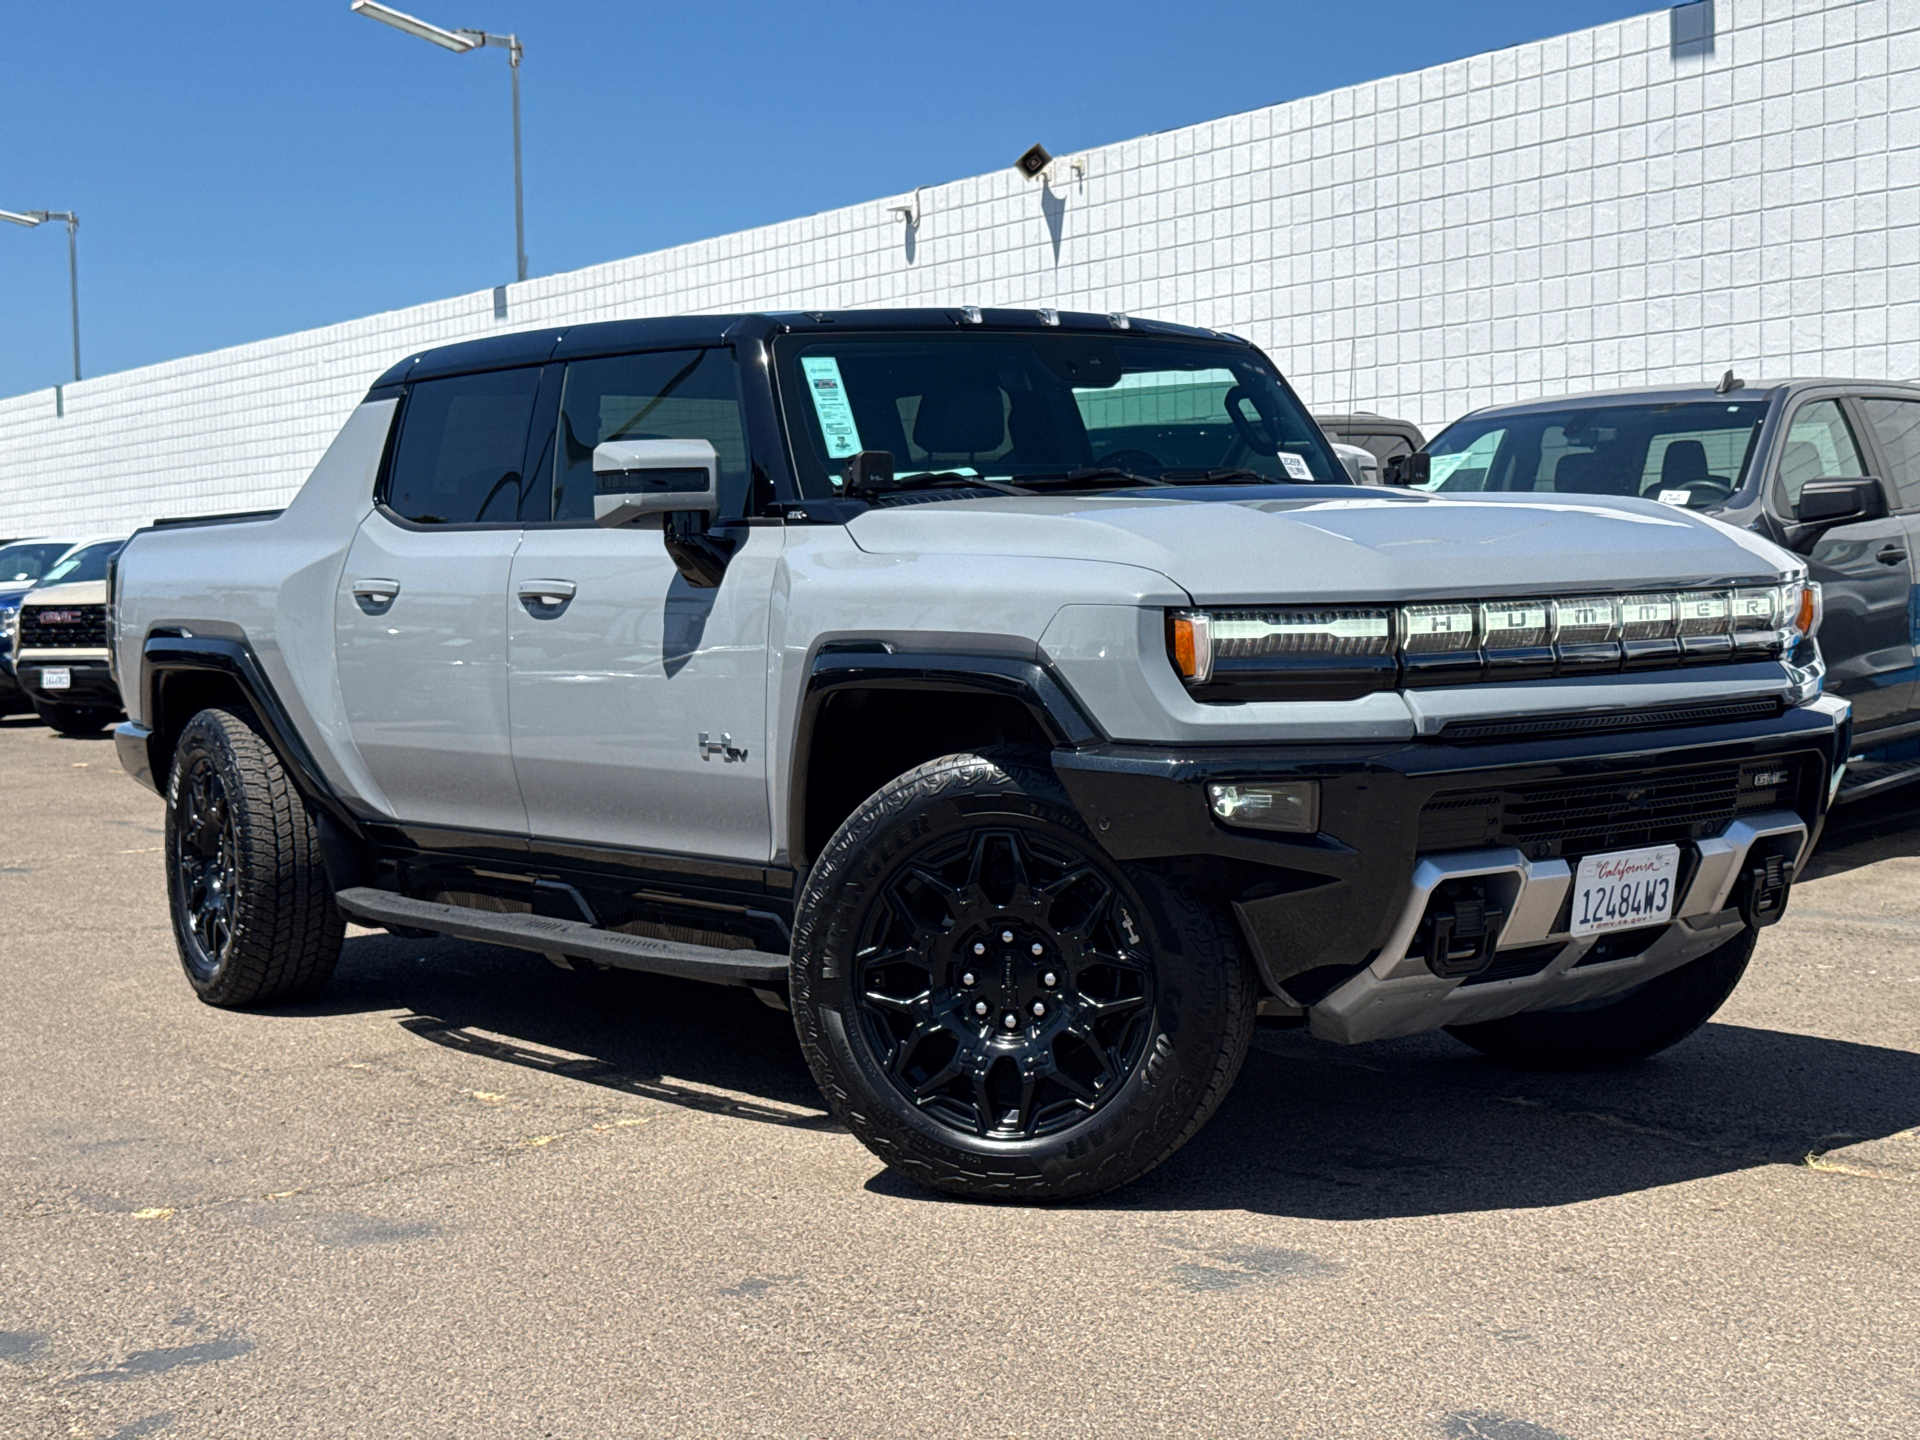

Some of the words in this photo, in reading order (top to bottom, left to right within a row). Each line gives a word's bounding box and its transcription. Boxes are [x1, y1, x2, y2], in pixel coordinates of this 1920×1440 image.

[1754, 771, 1788, 786] GMC
[1598, 858, 1660, 882] California
[821, 812, 931, 979] WRANGLER
[1579, 877, 1669, 925] 12484W3
[1596, 916, 1648, 929] dmv.ca.gov
